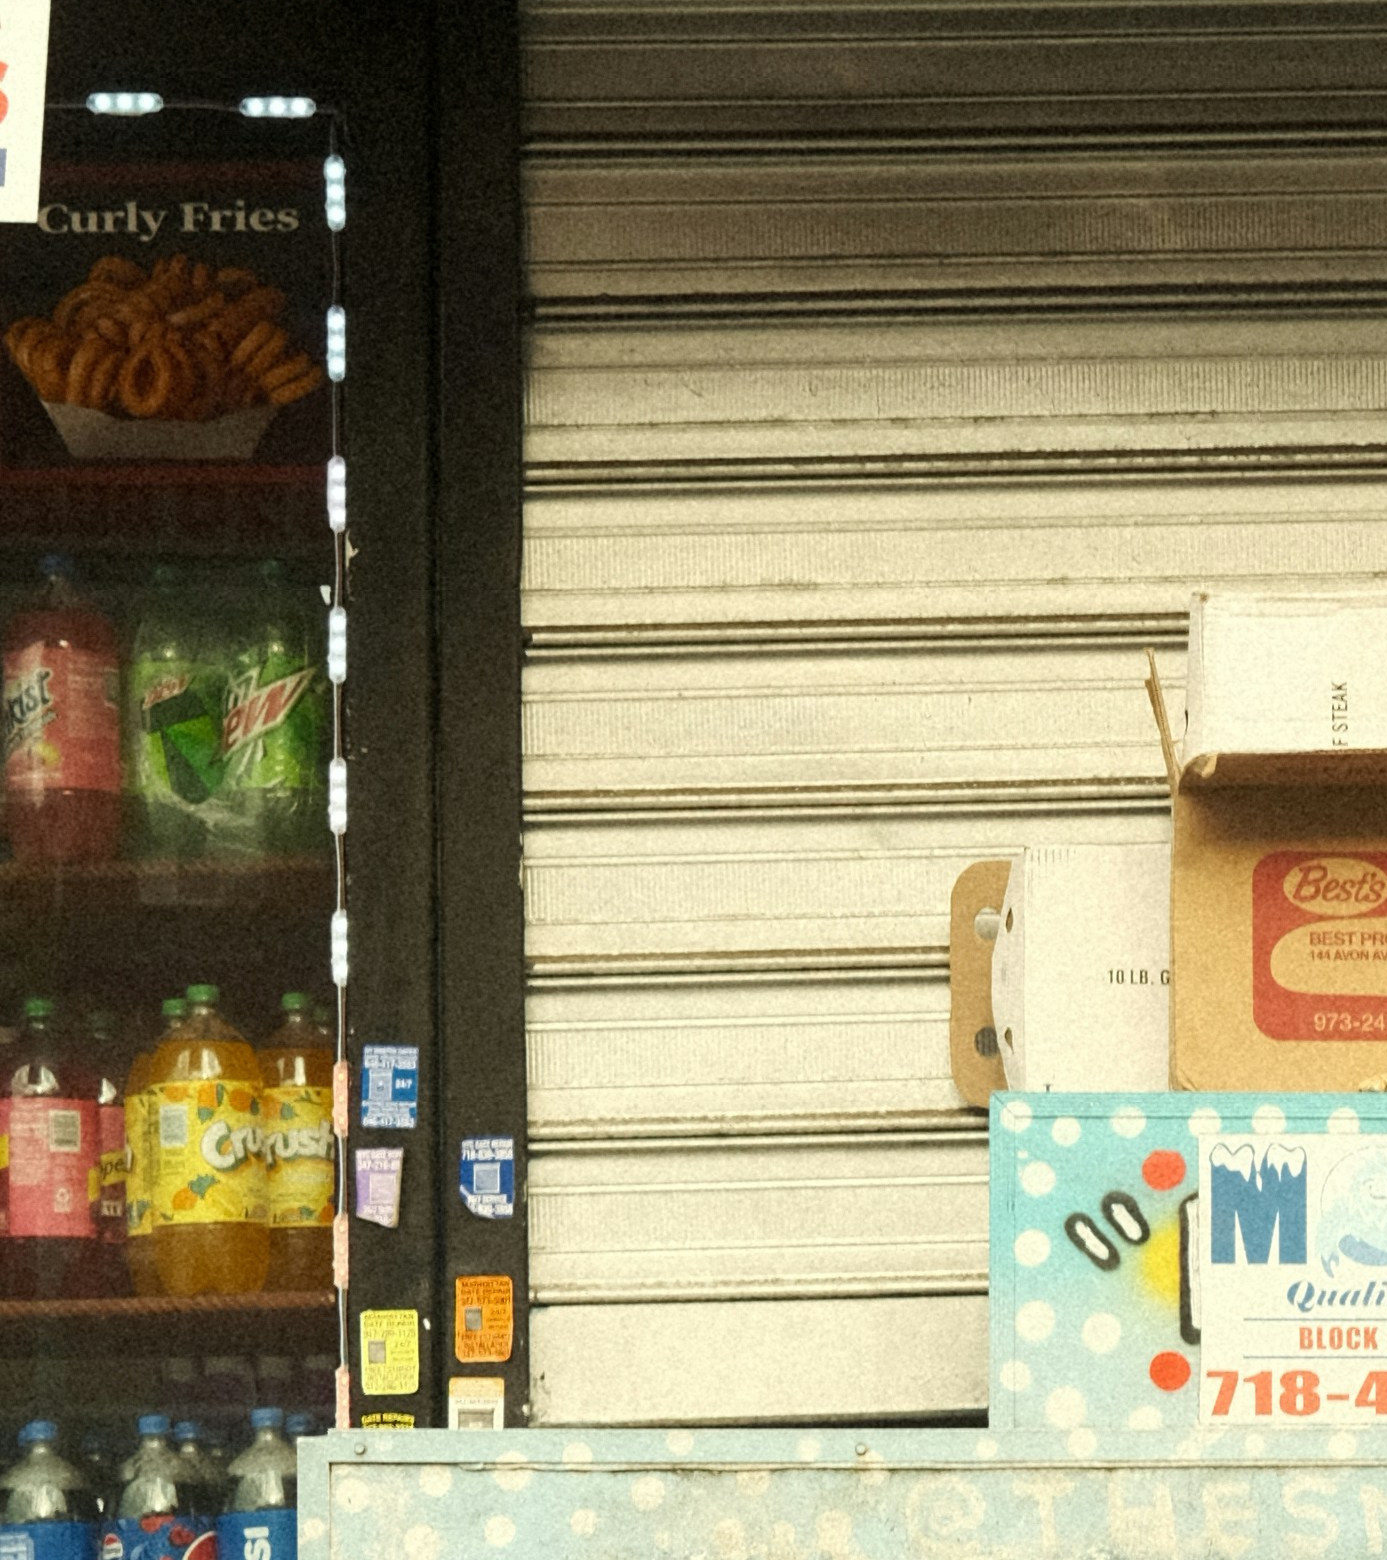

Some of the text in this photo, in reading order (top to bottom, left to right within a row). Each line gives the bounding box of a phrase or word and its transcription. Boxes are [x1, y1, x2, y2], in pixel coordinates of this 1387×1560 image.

[37, 201, 301, 241] Curly Fries
[1331, 681, 1349, 737] STEAK
[1291, 863, 1387, 904] Best's
[1308, 931, 1357, 947] BEST
[1333, 950, 1370, 962] AVON
[1108, 969, 1125, 985] 10
[1130, 969, 1154, 986] LB.
[1299, 1326, 1380, 1352] BLOCK
